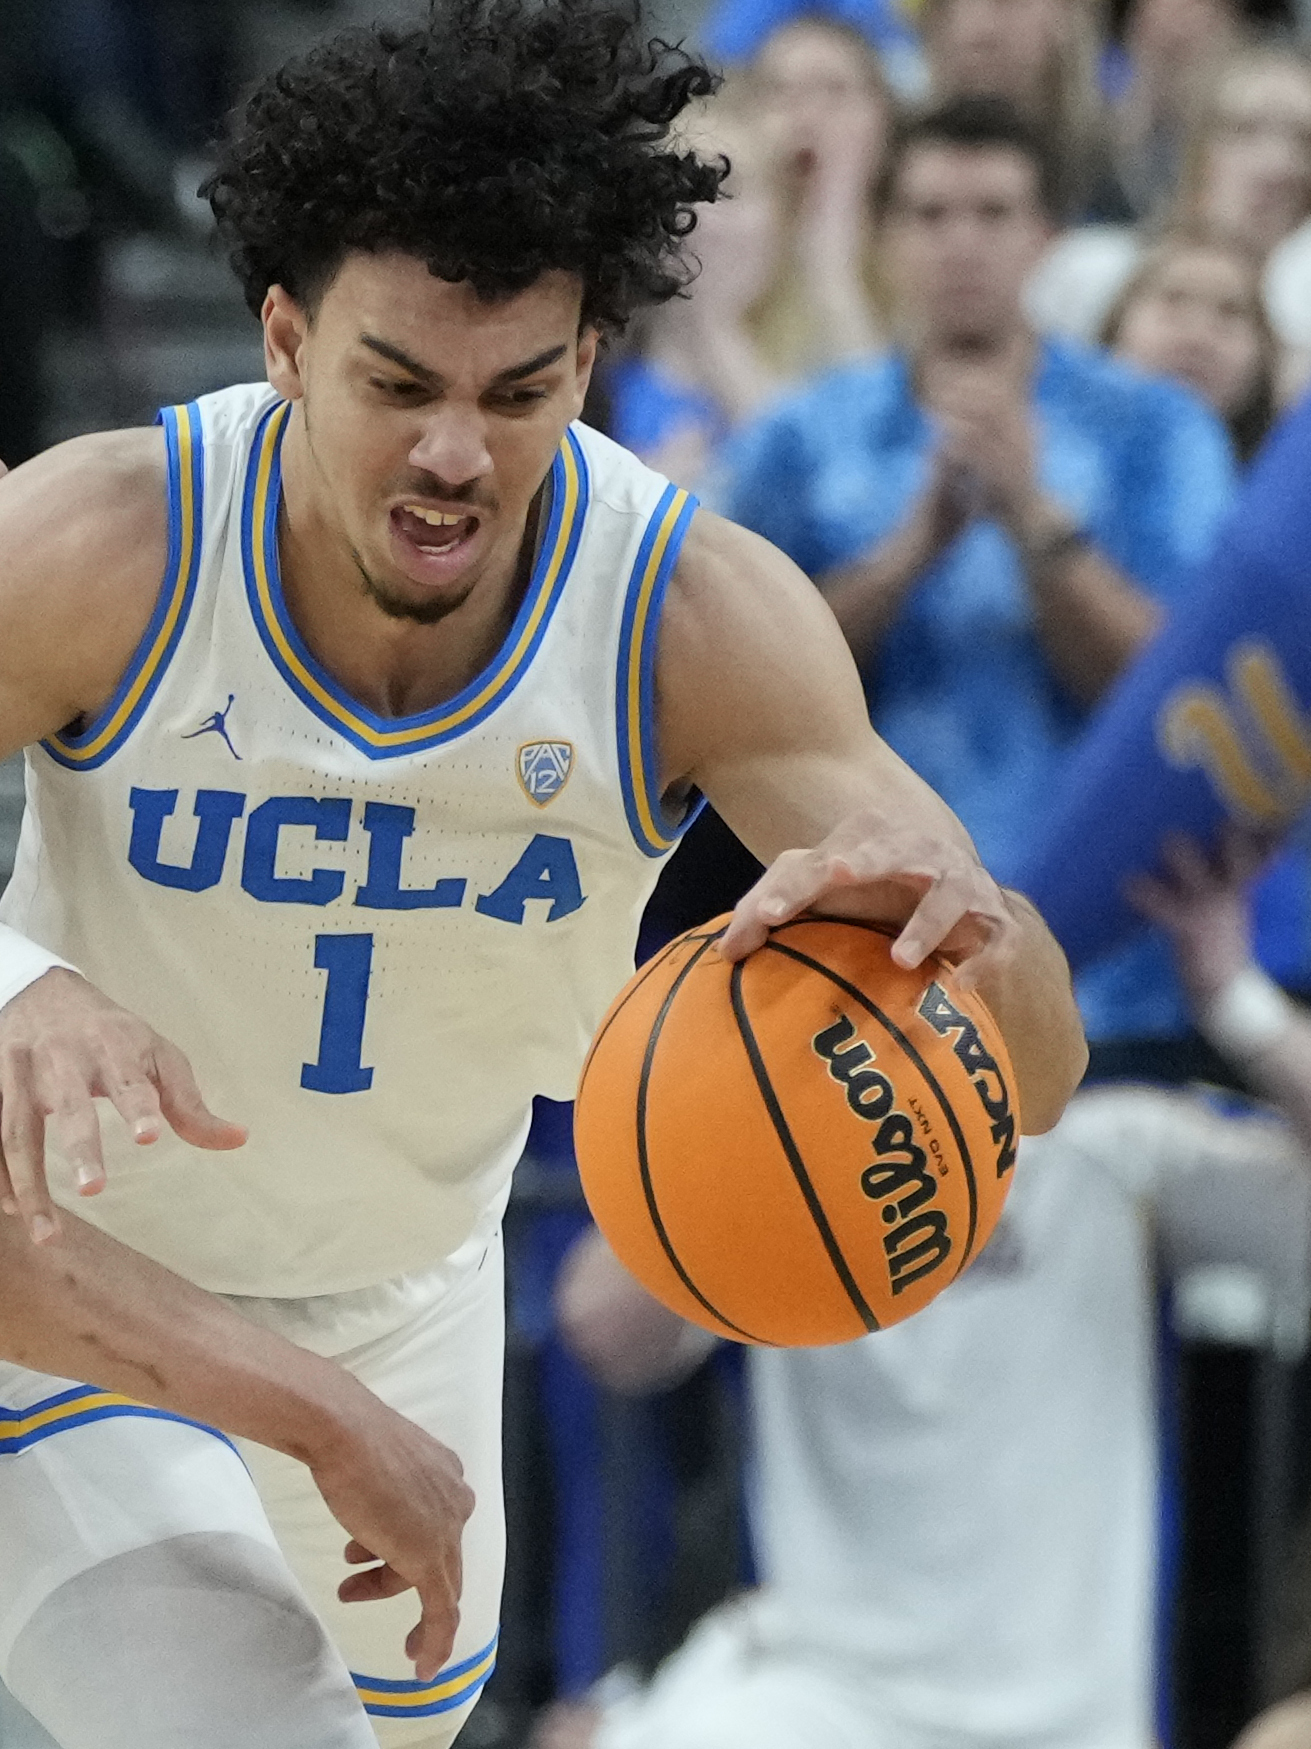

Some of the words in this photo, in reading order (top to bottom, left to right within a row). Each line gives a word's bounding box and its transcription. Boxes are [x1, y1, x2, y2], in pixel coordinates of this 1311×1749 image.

[520, 744, 571, 782] PAC
[529, 769, 558, 795] 12
[128, 786, 587, 925] UCLA
[300, 933, 375, 1095] 1
[916, 979, 1018, 1179] NCAA
[810, 1012, 954, 1298] Wilson
